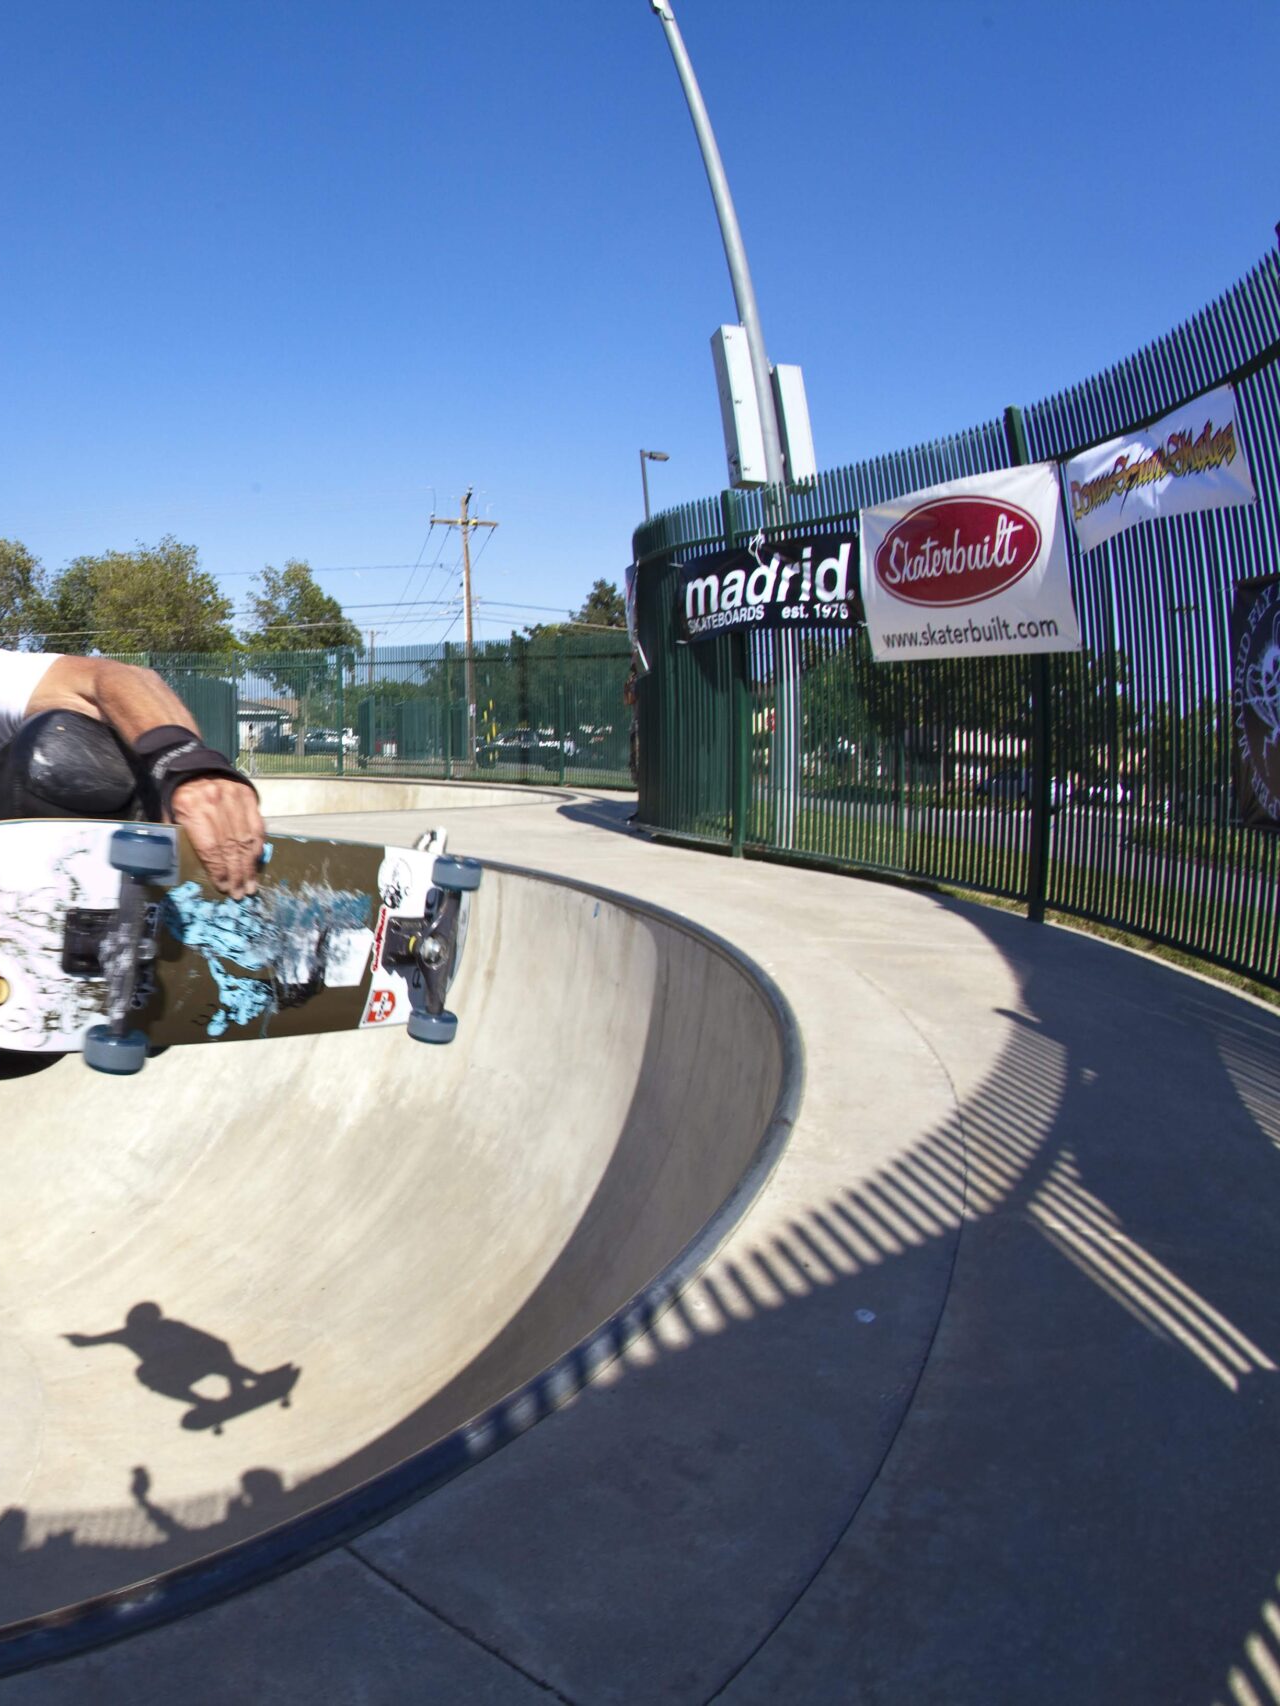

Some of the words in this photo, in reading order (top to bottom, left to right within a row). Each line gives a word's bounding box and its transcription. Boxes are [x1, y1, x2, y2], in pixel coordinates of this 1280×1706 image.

[686, 543, 852, 618] madrid
[885, 513, 1024, 584] Skaterbuilt
[687, 605, 765, 634] SKATEBOARDS
[781, 604, 809, 619] est.
[882, 616, 1059, 648] www.skaterbuilt.com
[1234, 632, 1251, 760] MADRID
